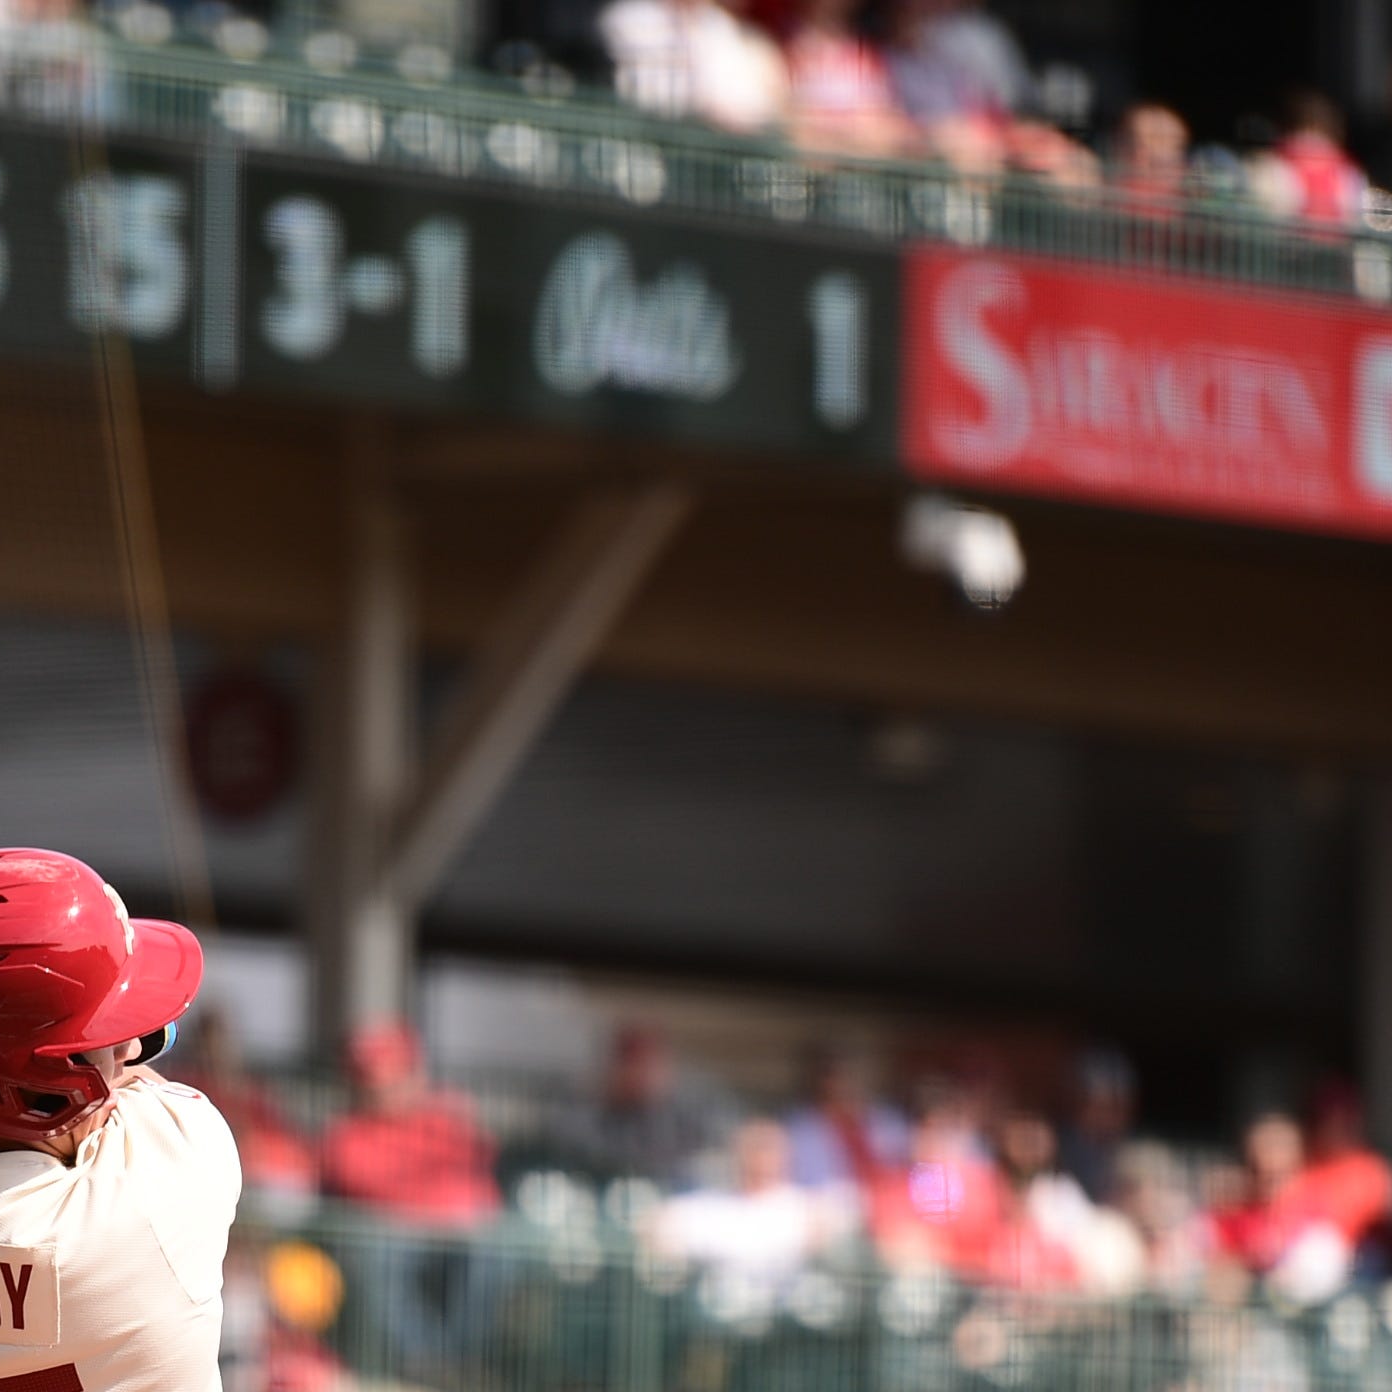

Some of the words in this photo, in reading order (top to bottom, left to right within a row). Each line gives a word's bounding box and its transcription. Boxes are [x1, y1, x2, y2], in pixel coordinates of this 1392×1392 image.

[63, 174, 189, 341] 15
[261, 194, 471, 379] 3-1
[814, 271, 868, 430] 1
